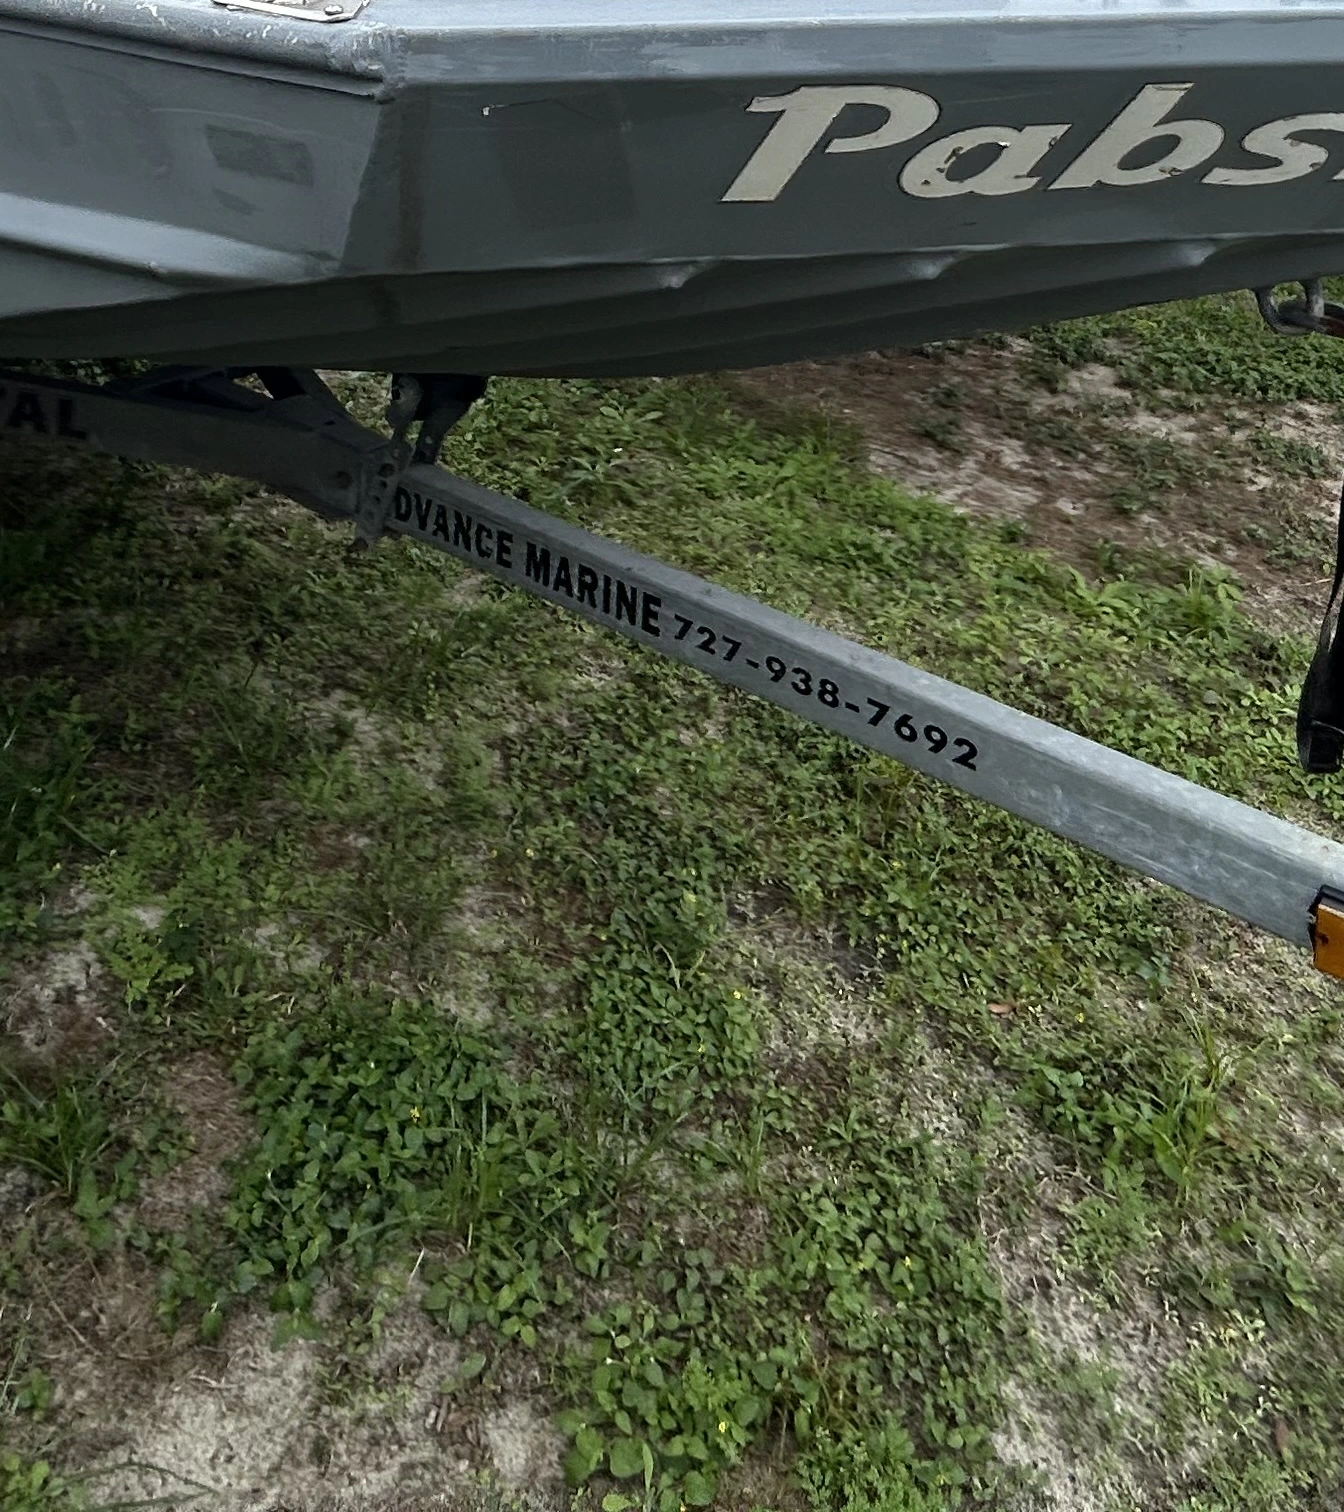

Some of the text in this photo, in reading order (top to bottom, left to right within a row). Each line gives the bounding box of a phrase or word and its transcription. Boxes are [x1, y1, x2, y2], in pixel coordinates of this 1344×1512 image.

[394, 486, 980, 772] DVANCE MARINE 727-938-7692
